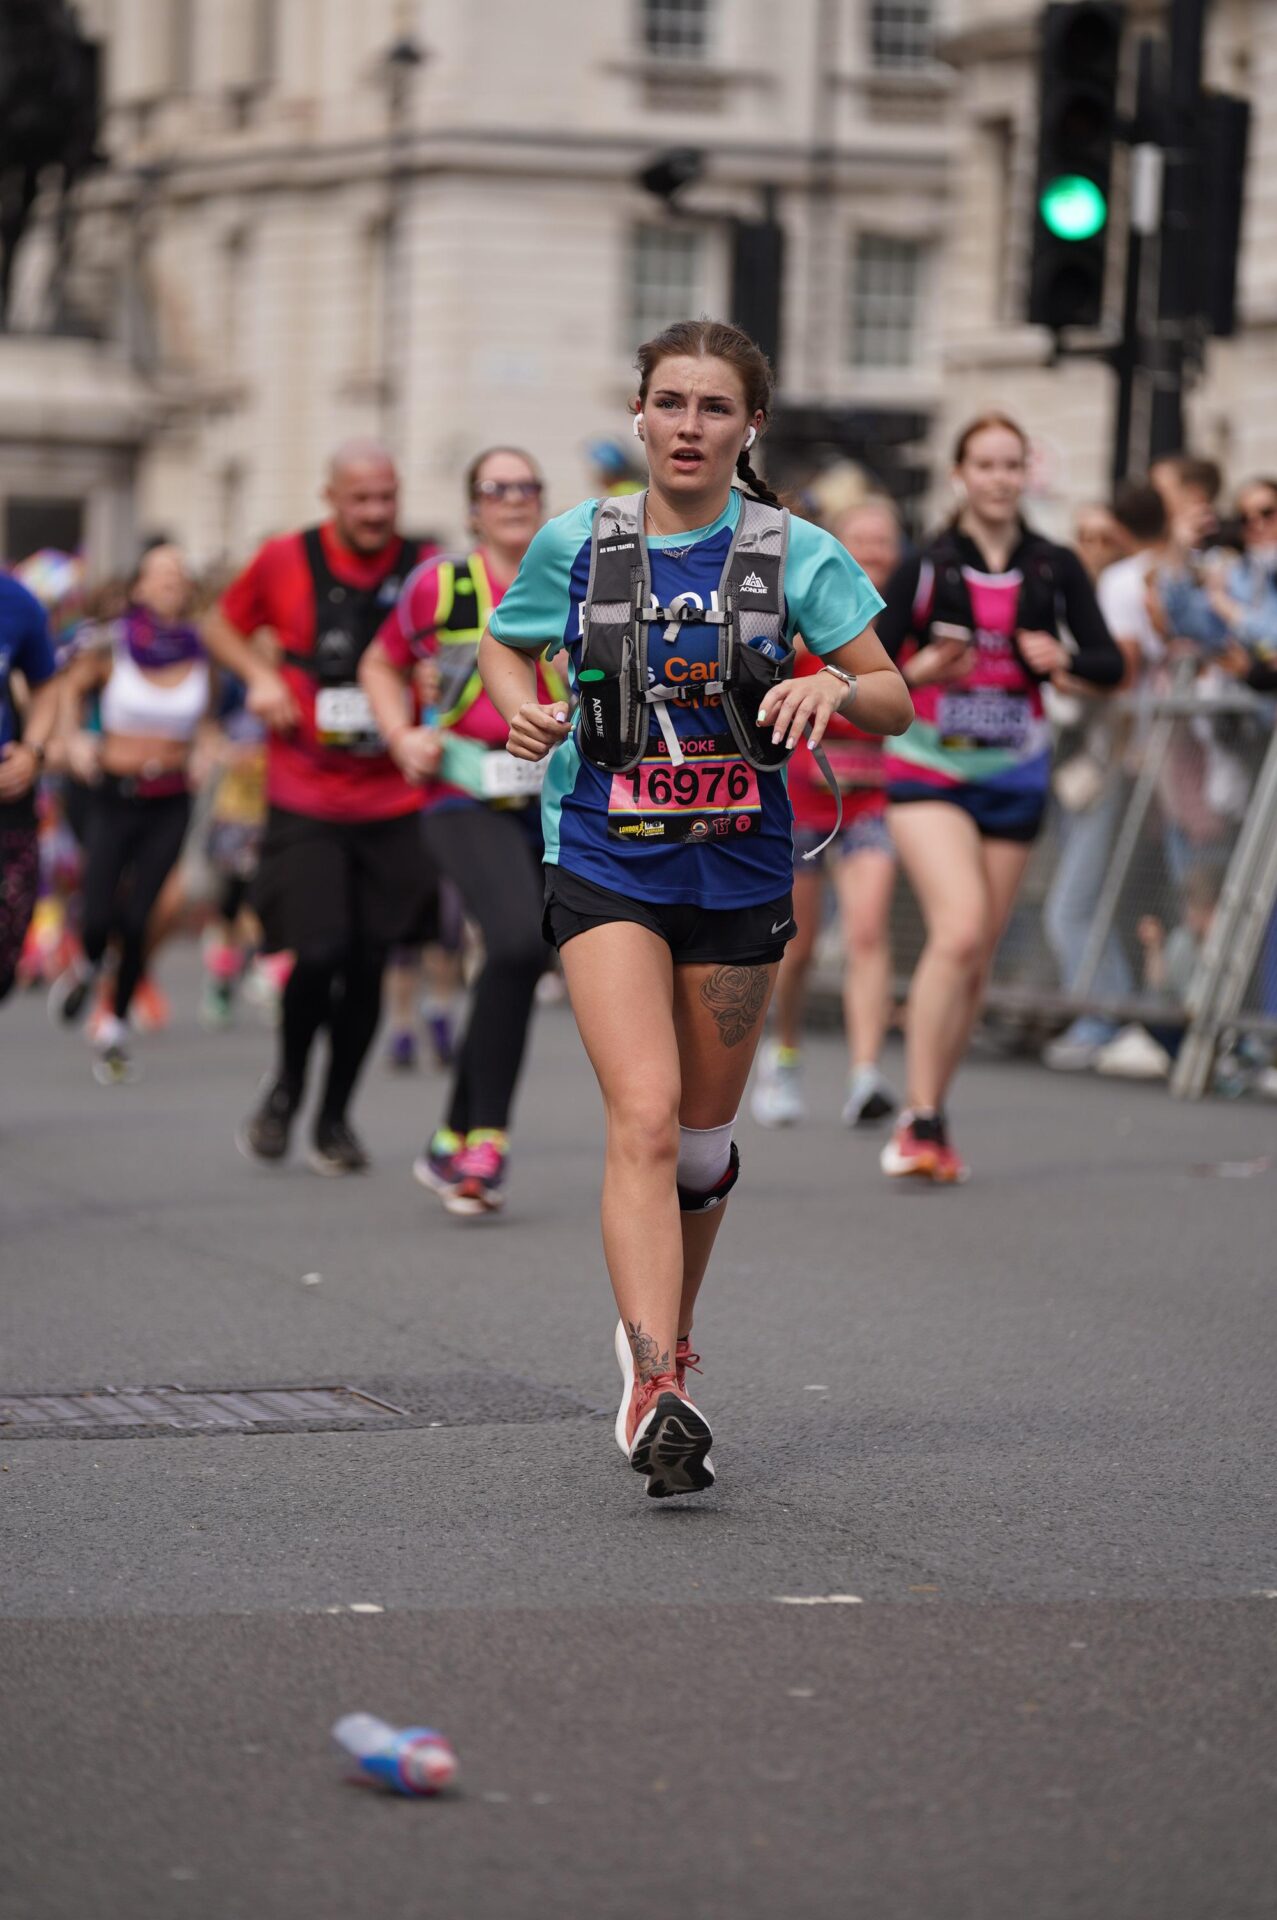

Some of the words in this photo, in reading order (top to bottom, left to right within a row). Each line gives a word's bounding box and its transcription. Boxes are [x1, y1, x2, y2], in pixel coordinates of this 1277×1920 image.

[739, 586, 768, 594] AONIJIE
[591, 697, 605, 738] AONIJIE
[657, 739, 716, 753] BOOKE
[625, 763, 749, 806] 16976
[619, 824, 640, 834] LONDON
